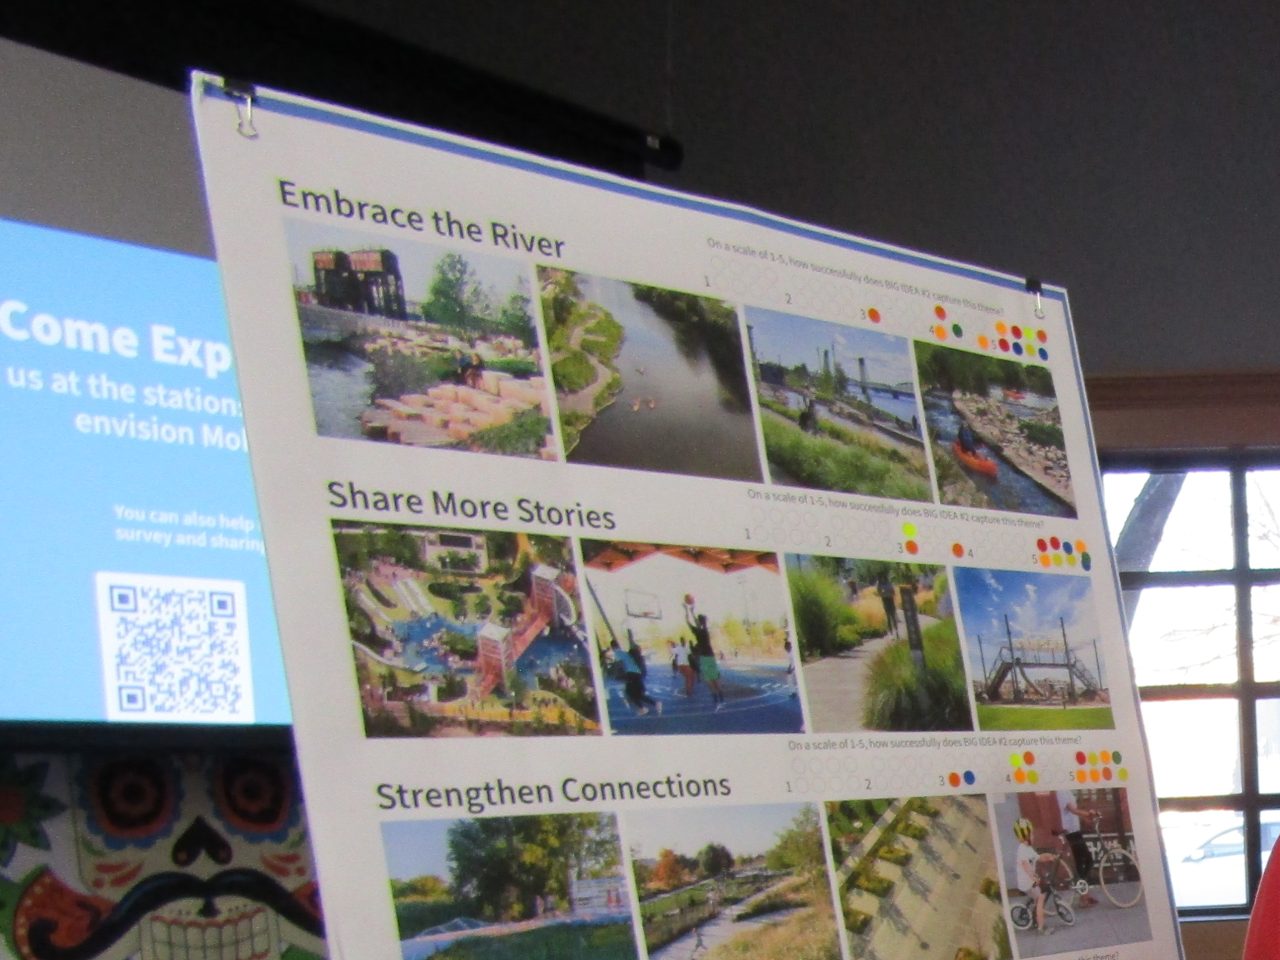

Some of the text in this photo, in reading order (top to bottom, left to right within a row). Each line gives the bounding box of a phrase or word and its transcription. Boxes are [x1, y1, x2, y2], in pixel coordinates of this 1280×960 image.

[279, 180, 566, 258] Embrace the River
[785, 293, 792, 305] 2
[0, 300, 232, 379] Come Exp
[7, 366, 44, 391] us
[50, 370, 82, 396] at
[87, 372, 136, 404] the
[74, 411, 195, 445] envision
[327, 480, 617, 531] Share More Stories
[747, 488, 762, 500] On
[764, 491, 772, 500] a
[772, 490, 796, 503] scale
[113, 503, 255, 533] You can also help
[115, 527, 173, 548] survey
[175, 531, 207, 548] and
[824, 535, 832, 547] 2
[788, 739, 802, 751] On
[804, 742, 811, 750] a
[812, 739, 838, 750] scale
[839, 739, 849, 750] of
[869, 738, 889, 748] how
[942, 737, 963, 748] does
[1039, 735, 1055, 746] this
[377, 773, 732, 815] Strengthen Connections
[864, 778, 872, 790] 2
